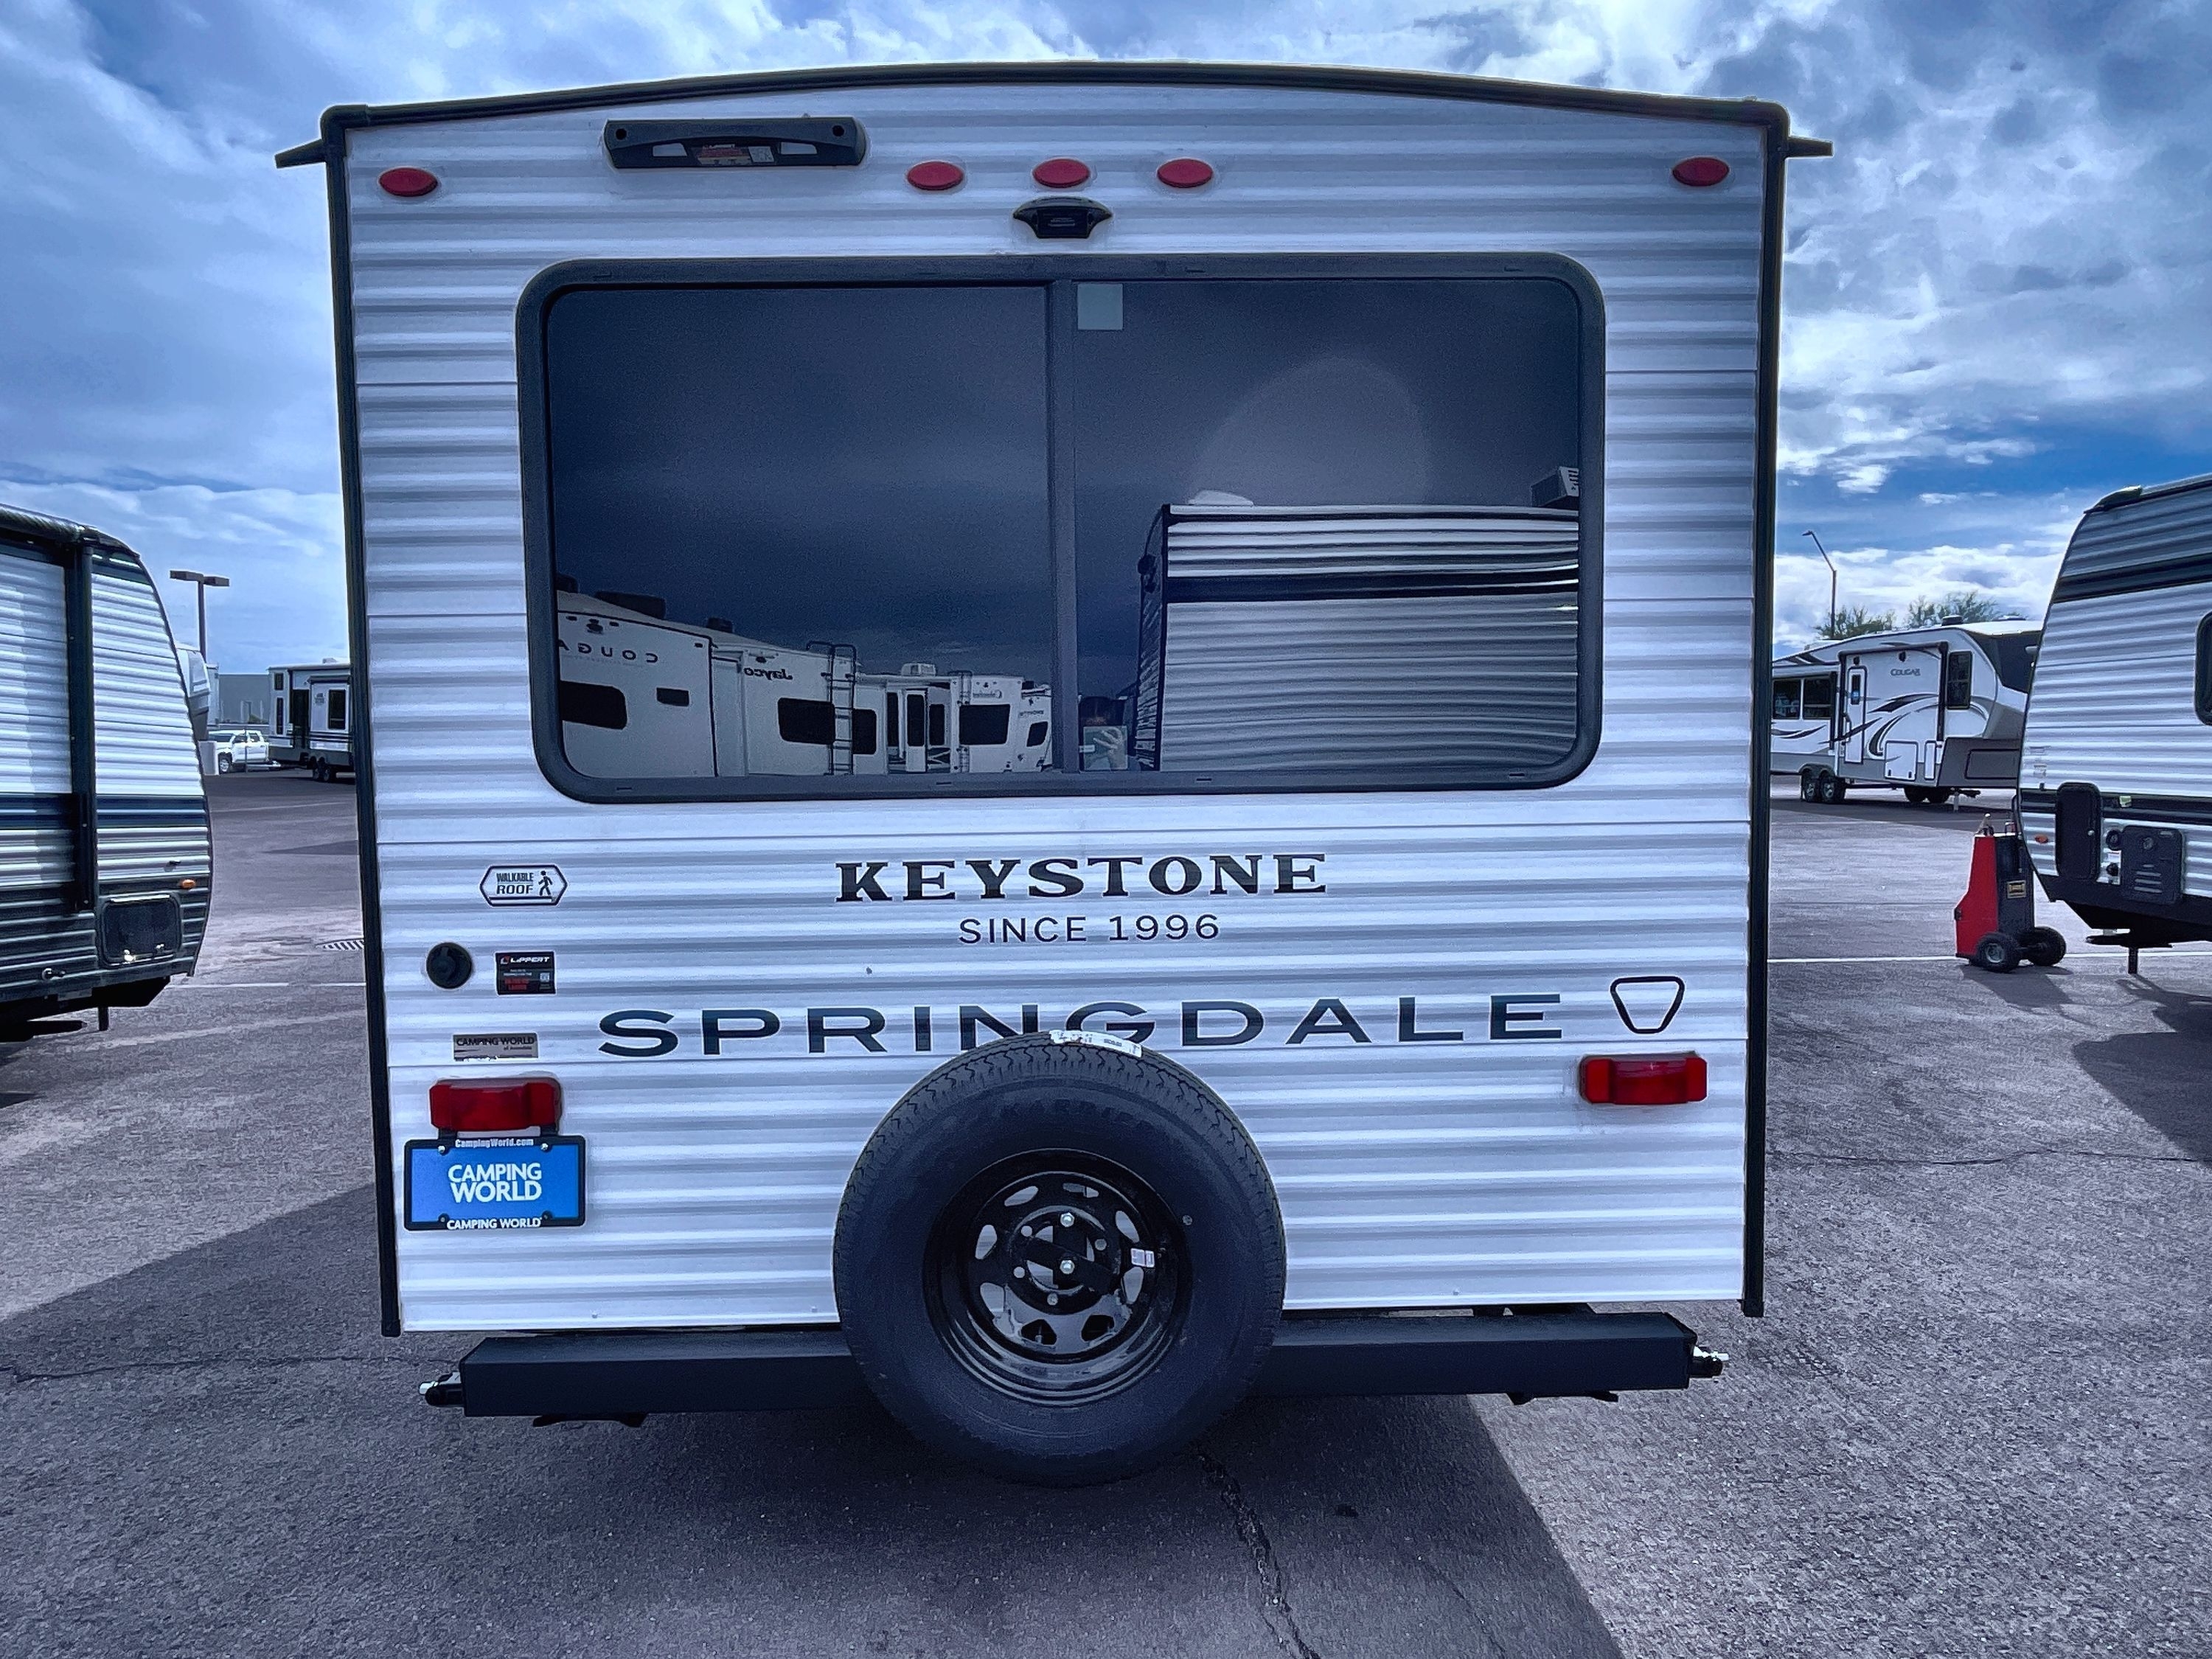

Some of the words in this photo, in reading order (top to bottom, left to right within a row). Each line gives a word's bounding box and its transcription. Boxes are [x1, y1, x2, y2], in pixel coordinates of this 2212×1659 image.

[496, 872, 534, 883] WALKABLE
[835, 853, 1326, 902] KEYSTONE
[496, 885, 533, 894] ROOF
[959, 917, 1088, 945] SINCE
[1108, 914, 1220, 941] 1996
[597, 993, 1563, 1057] SPRINGDALE
[456, 1037, 499, 1046] CAMPING
[501, 1035, 535, 1045] WORLD
[455, 1138, 534, 1149] CampingWorld.com
[448, 1162, 542, 1183] CAMPING
[450, 1180, 542, 1203] WORLD
[447, 1219, 498, 1230] CAMPING
[500, 1218, 540, 1228] WORLD
